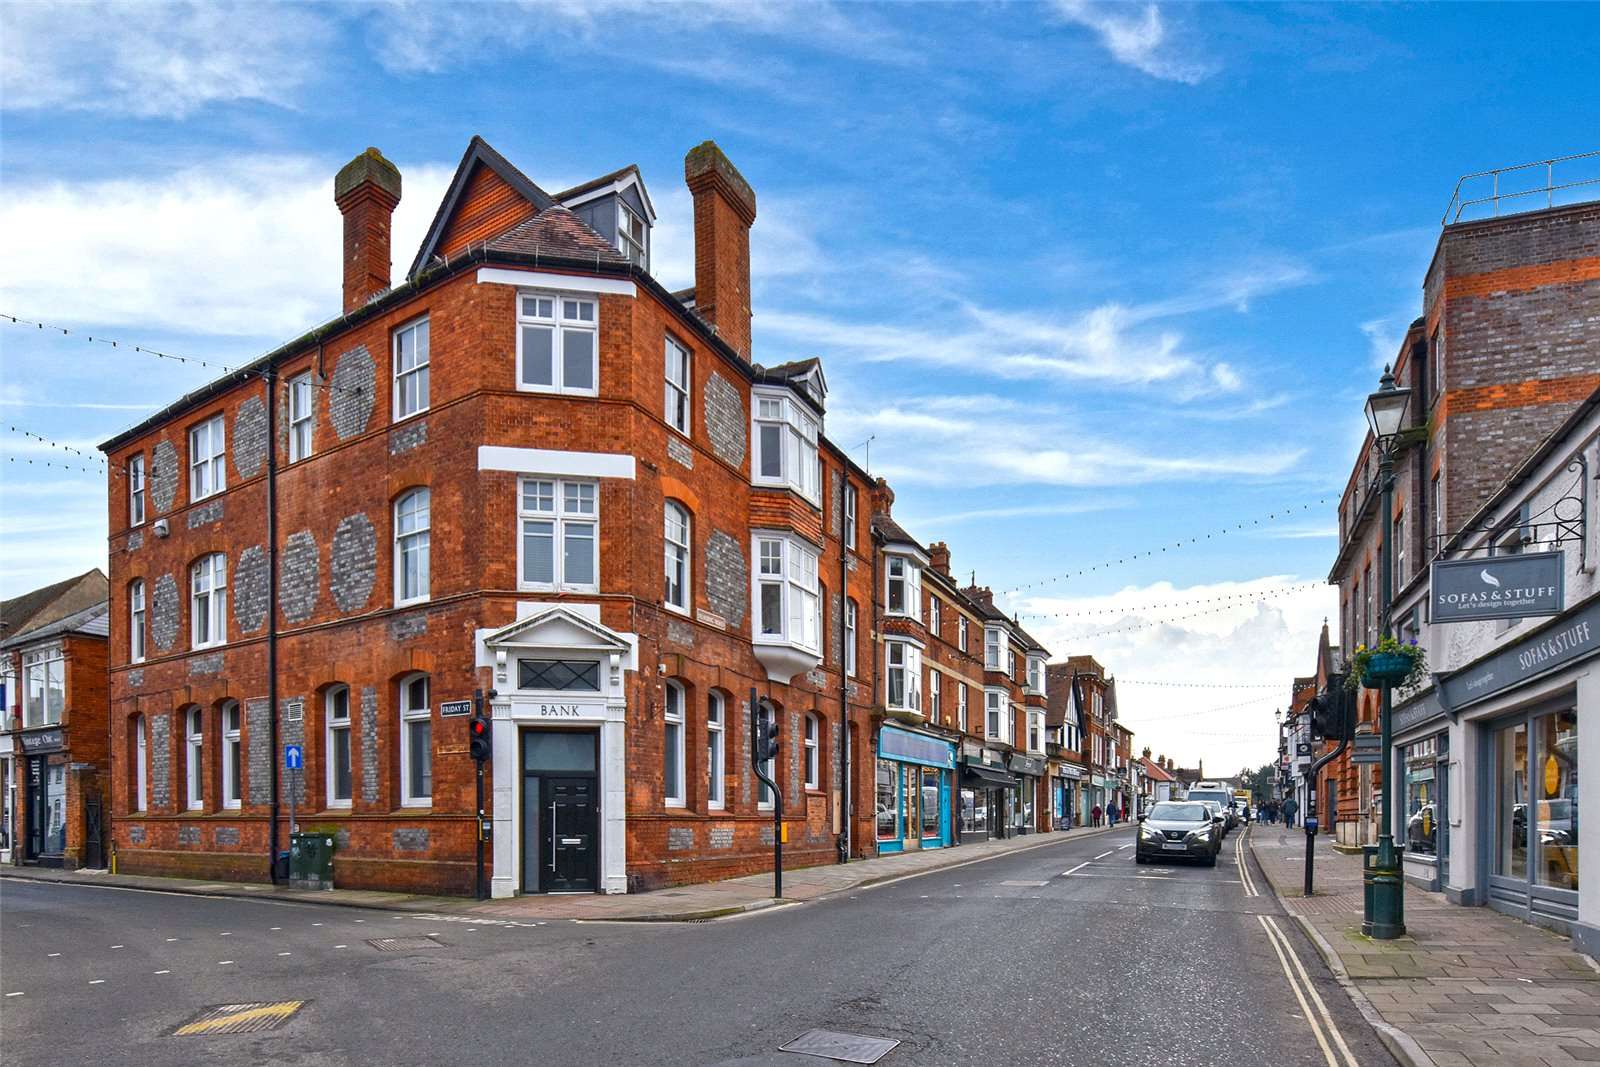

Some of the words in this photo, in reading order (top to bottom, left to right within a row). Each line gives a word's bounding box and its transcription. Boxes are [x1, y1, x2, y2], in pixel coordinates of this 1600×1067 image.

[1439, 592, 1487, 604] SOFAS
[1505, 587, 1556, 599] STUFF
[1458, 601, 1476, 609] Let's
[1478, 599, 1502, 609] design
[1504, 598, 1536, 607] together
[442, 704, 461, 713] FRIDAY
[541, 705, 580, 716] BANK
